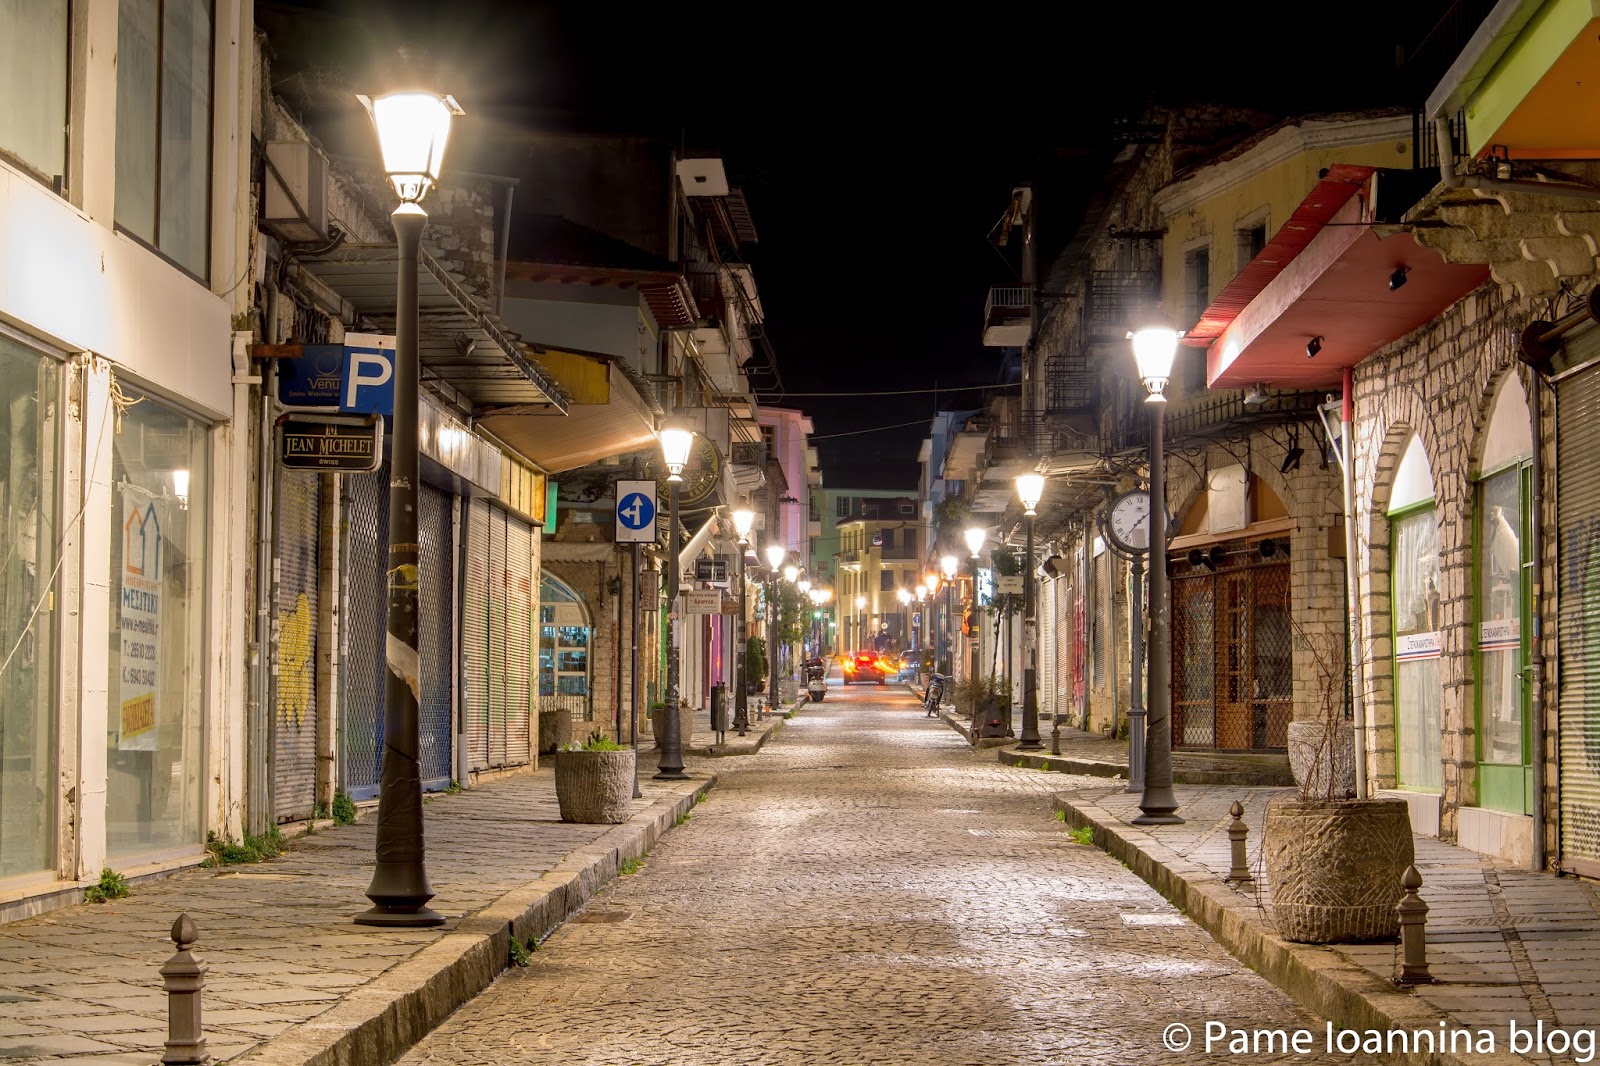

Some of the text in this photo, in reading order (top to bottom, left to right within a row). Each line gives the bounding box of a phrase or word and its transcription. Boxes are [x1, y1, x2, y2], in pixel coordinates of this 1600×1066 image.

[307, 378, 340, 390] Venu
[346, 353, 392, 408] P
[284, 438, 372, 458] JEAN MICHELET
